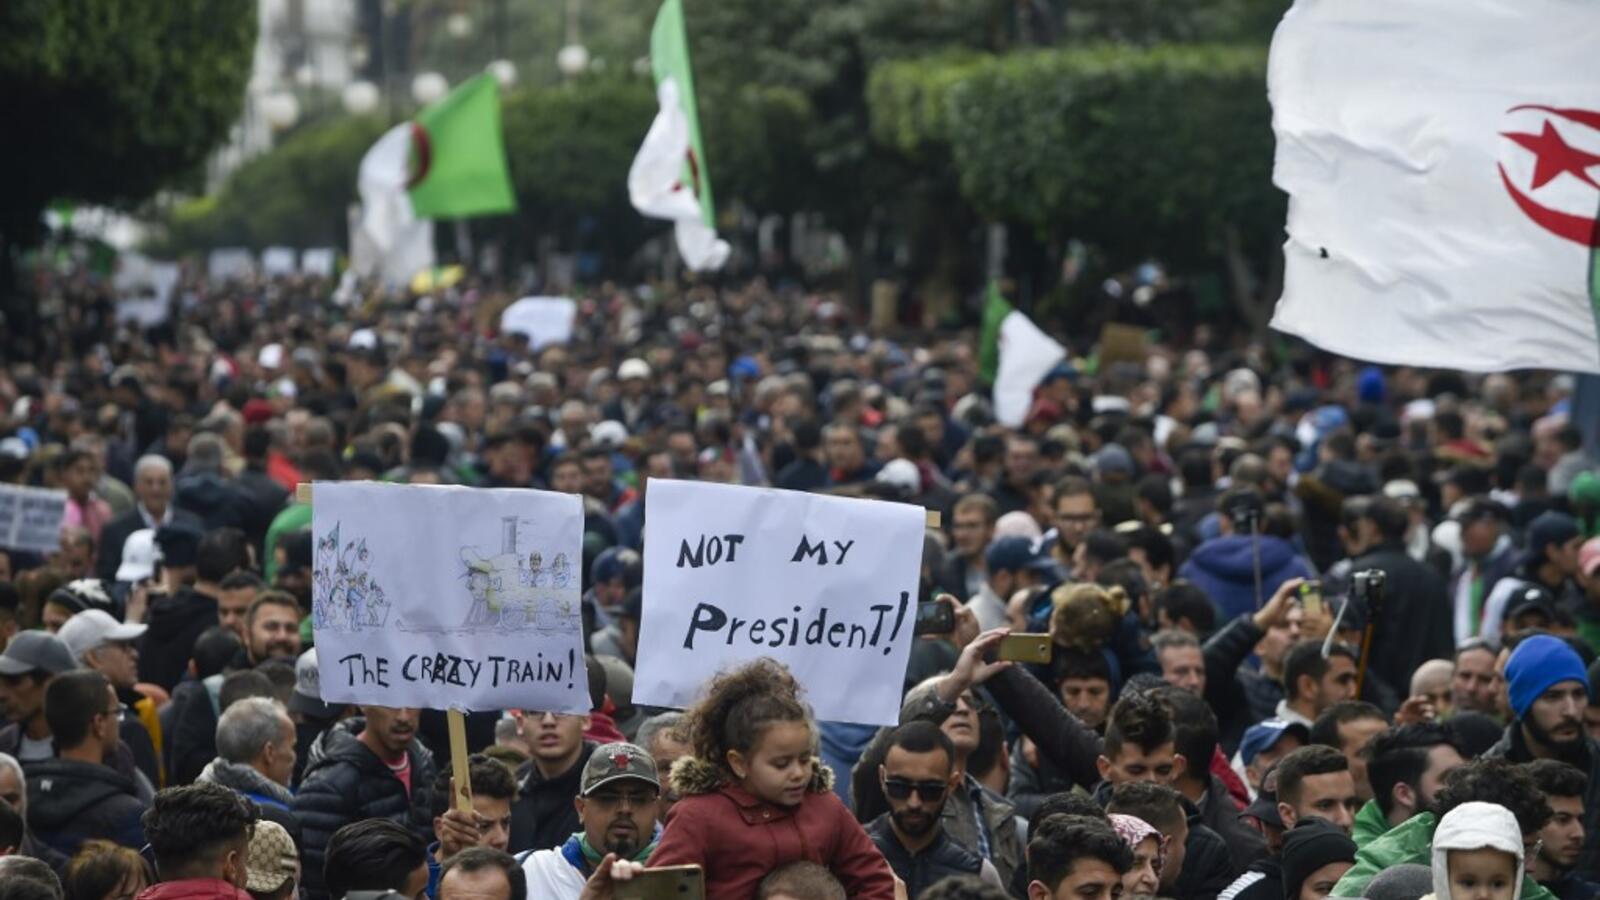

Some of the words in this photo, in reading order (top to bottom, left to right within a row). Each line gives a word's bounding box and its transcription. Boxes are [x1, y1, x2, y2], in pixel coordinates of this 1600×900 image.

[676, 534, 744, 568] NOT
[790, 534, 855, 565] MY
[402, 651, 482, 689] CRAZY
